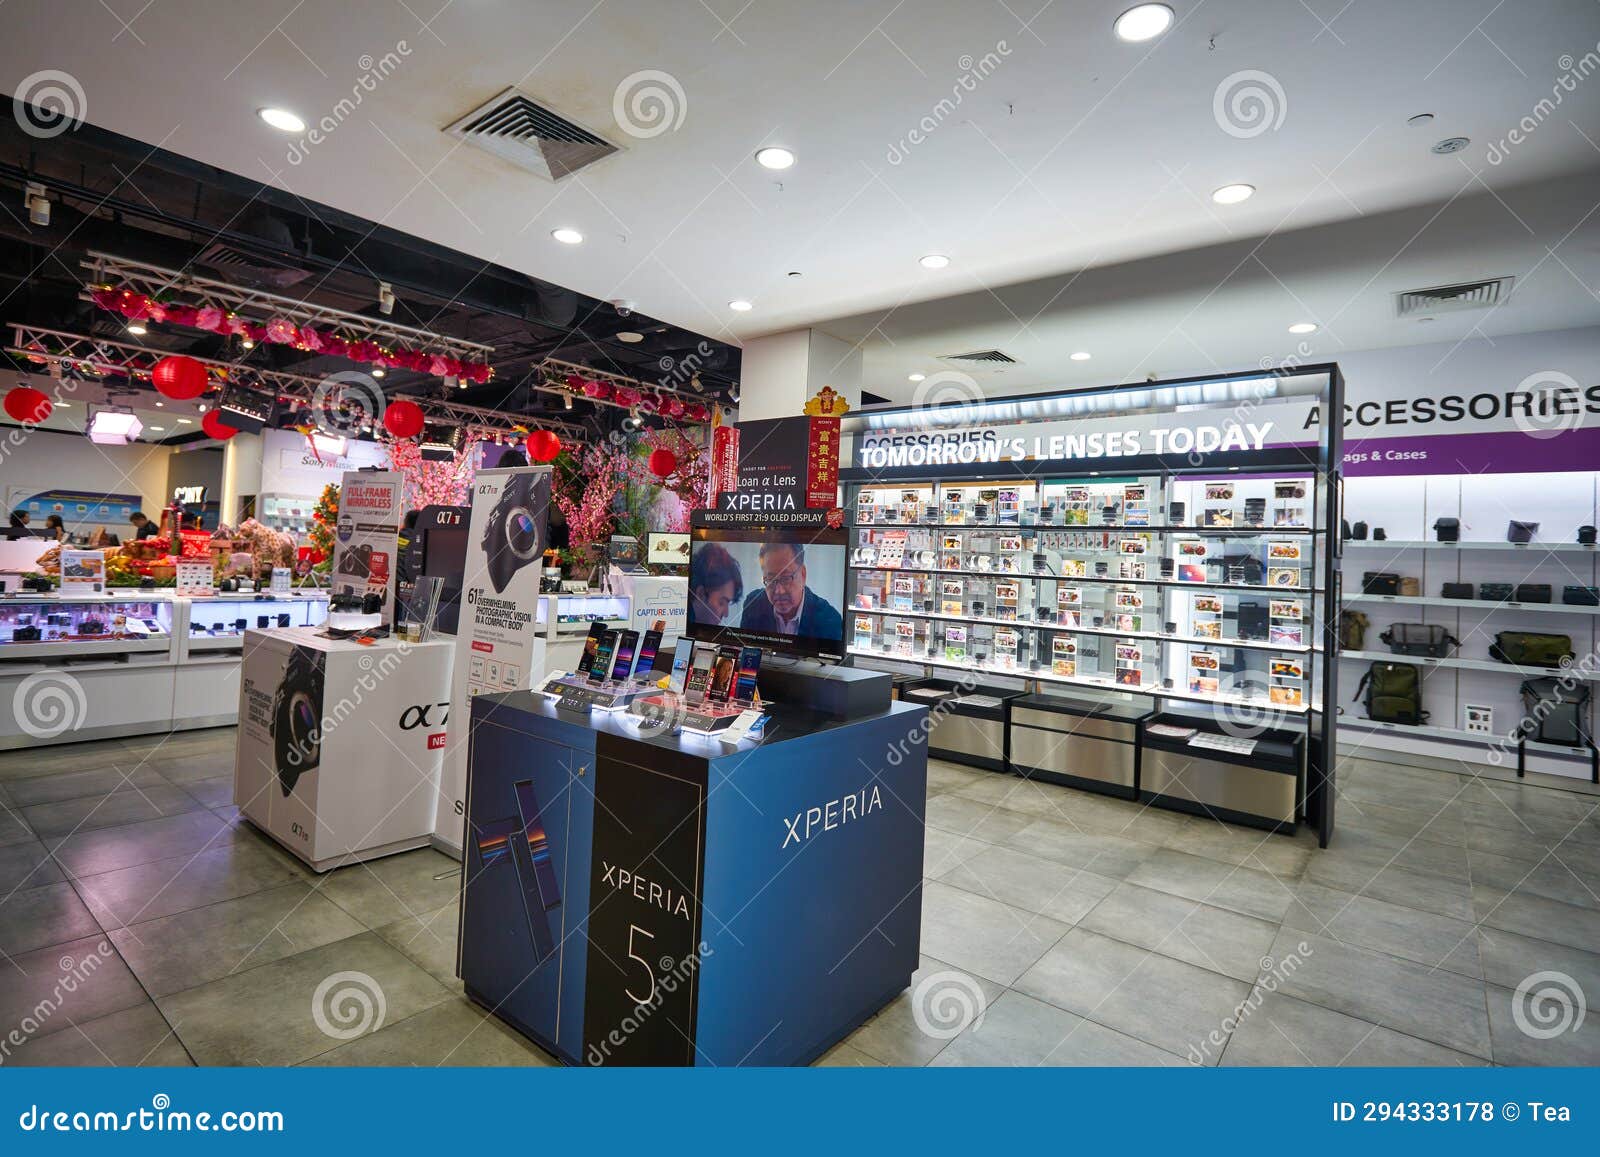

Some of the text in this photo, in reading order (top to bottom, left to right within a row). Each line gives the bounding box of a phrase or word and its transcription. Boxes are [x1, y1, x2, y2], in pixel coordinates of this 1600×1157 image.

[860, 422, 1274, 468] TOMORROW'S LENSES TODAY
[1343, 450, 1428, 464] ags & Cases
[737, 476, 759, 487] Loan
[773, 475, 797, 486] Lens
[726, 493, 796, 511] XPERIA
[704, 513, 734, 521] WORLD'S
[735, 513, 753, 521] FIRST
[754, 513, 769, 521] 21:9
[770, 513, 789, 521] OLED
[791, 513, 823, 522] DISPLAY
[467, 588, 478, 605] 61
[477, 597, 516, 611] OVERWHELMING
[475, 606, 532, 623] PHOTOGRAPHIC VISION
[485, 617, 508, 629] COMPACT
[508, 620, 524, 631] BODY
[432, 736, 446, 746] NE
[781, 785, 883, 849] XPERIA
[601, 861, 690, 921] XPERIA
[624, 924, 656, 1005] 5
